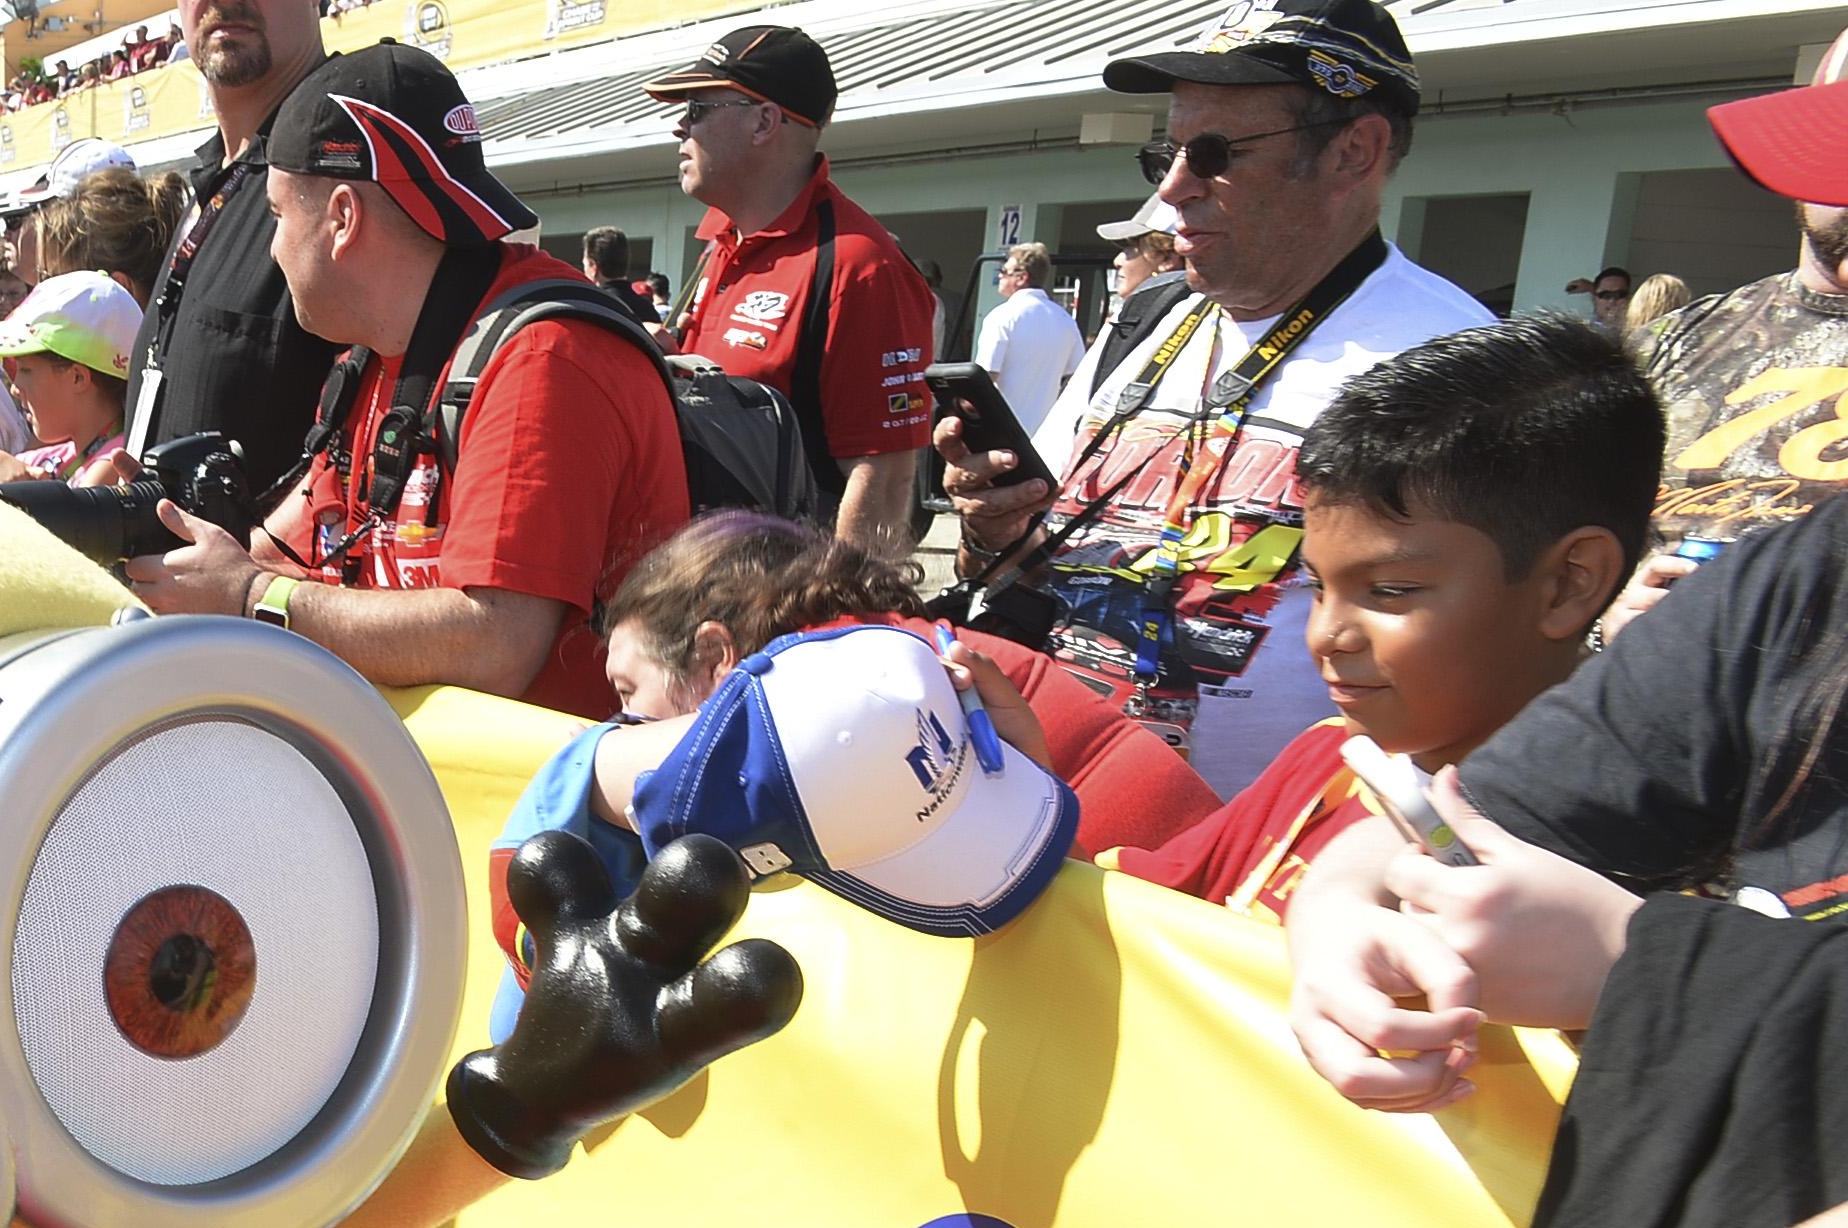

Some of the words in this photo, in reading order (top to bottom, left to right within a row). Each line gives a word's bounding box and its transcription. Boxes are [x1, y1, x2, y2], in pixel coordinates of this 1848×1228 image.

[1001, 212, 1020, 245] 12
[1153, 313, 1199, 365] Nikon
[1257, 309, 1315, 361] Nikon
